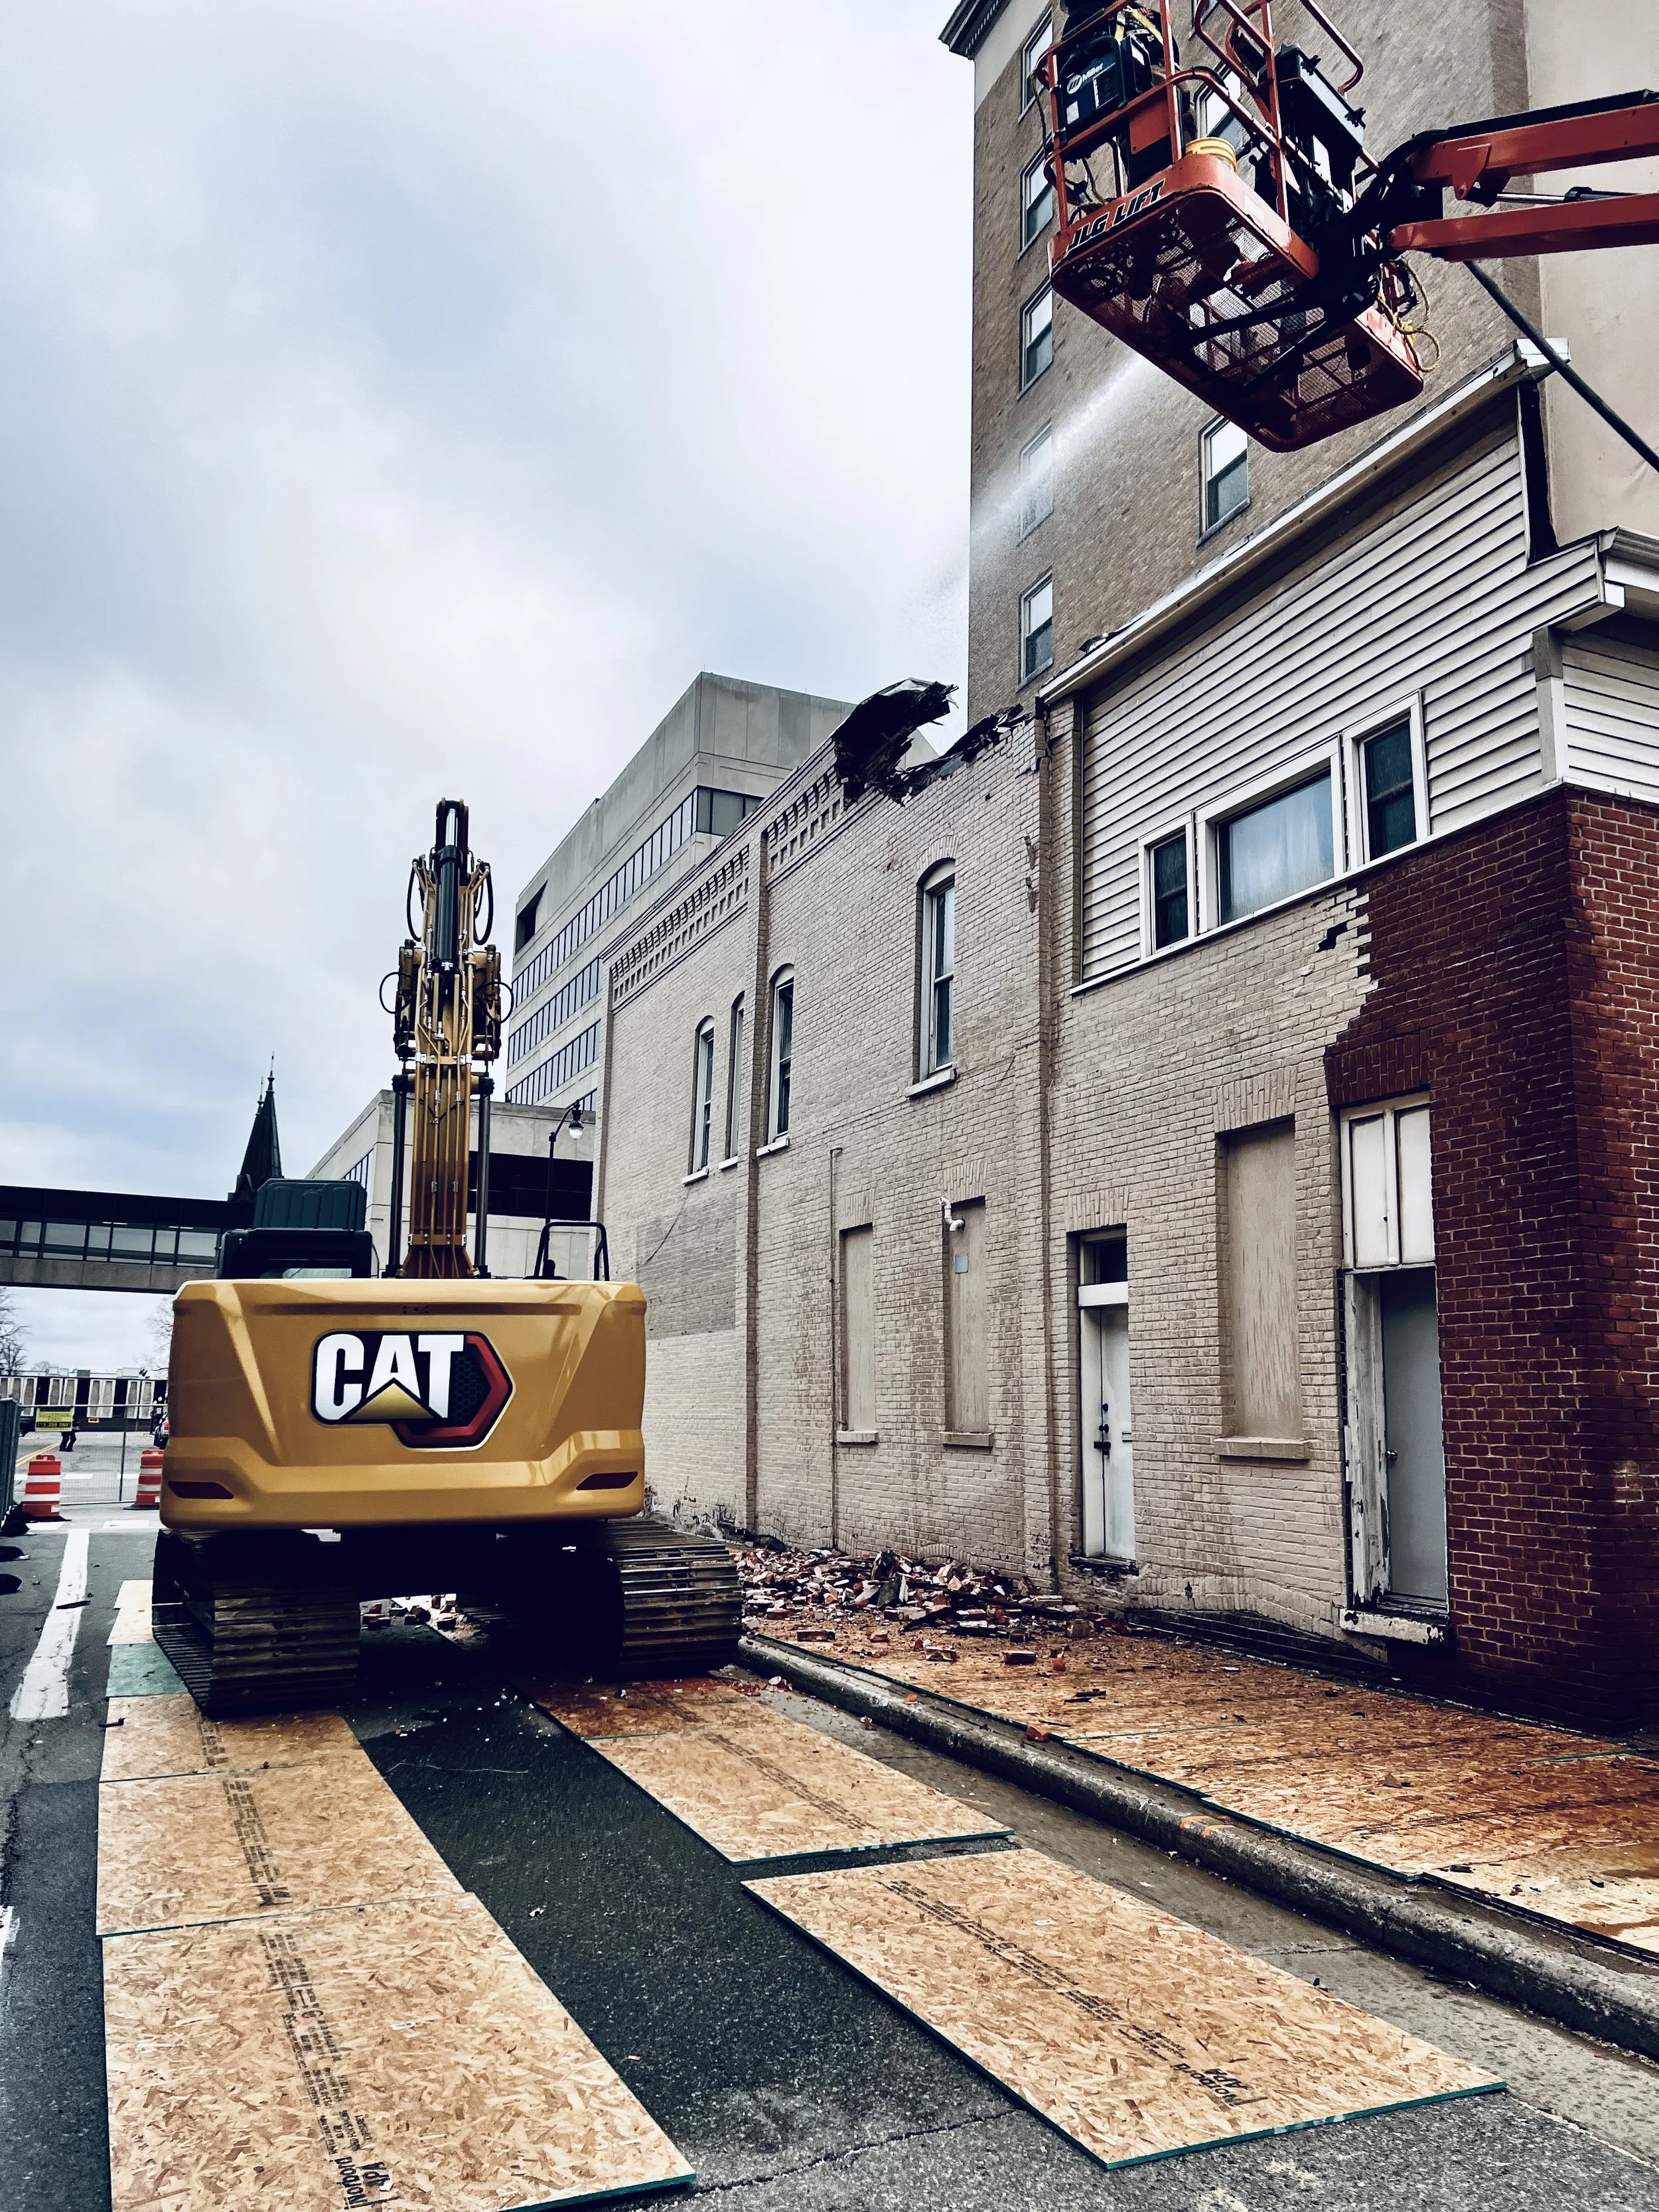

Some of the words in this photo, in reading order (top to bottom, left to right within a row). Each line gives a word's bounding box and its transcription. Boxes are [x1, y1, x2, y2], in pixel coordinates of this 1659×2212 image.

[1082, 63, 1104, 82] Miller
[1067, 212, 1110, 252] JLG
[1112, 178, 1166, 227] LIFT
[315, 1334, 464, 1420] CAT
[1173, 2063, 1238, 2105] Norbord
[1204, 2068, 1249, 2089] APA
[334, 2156, 368, 2205] Norbord
[356, 2161, 391, 2188] APA
